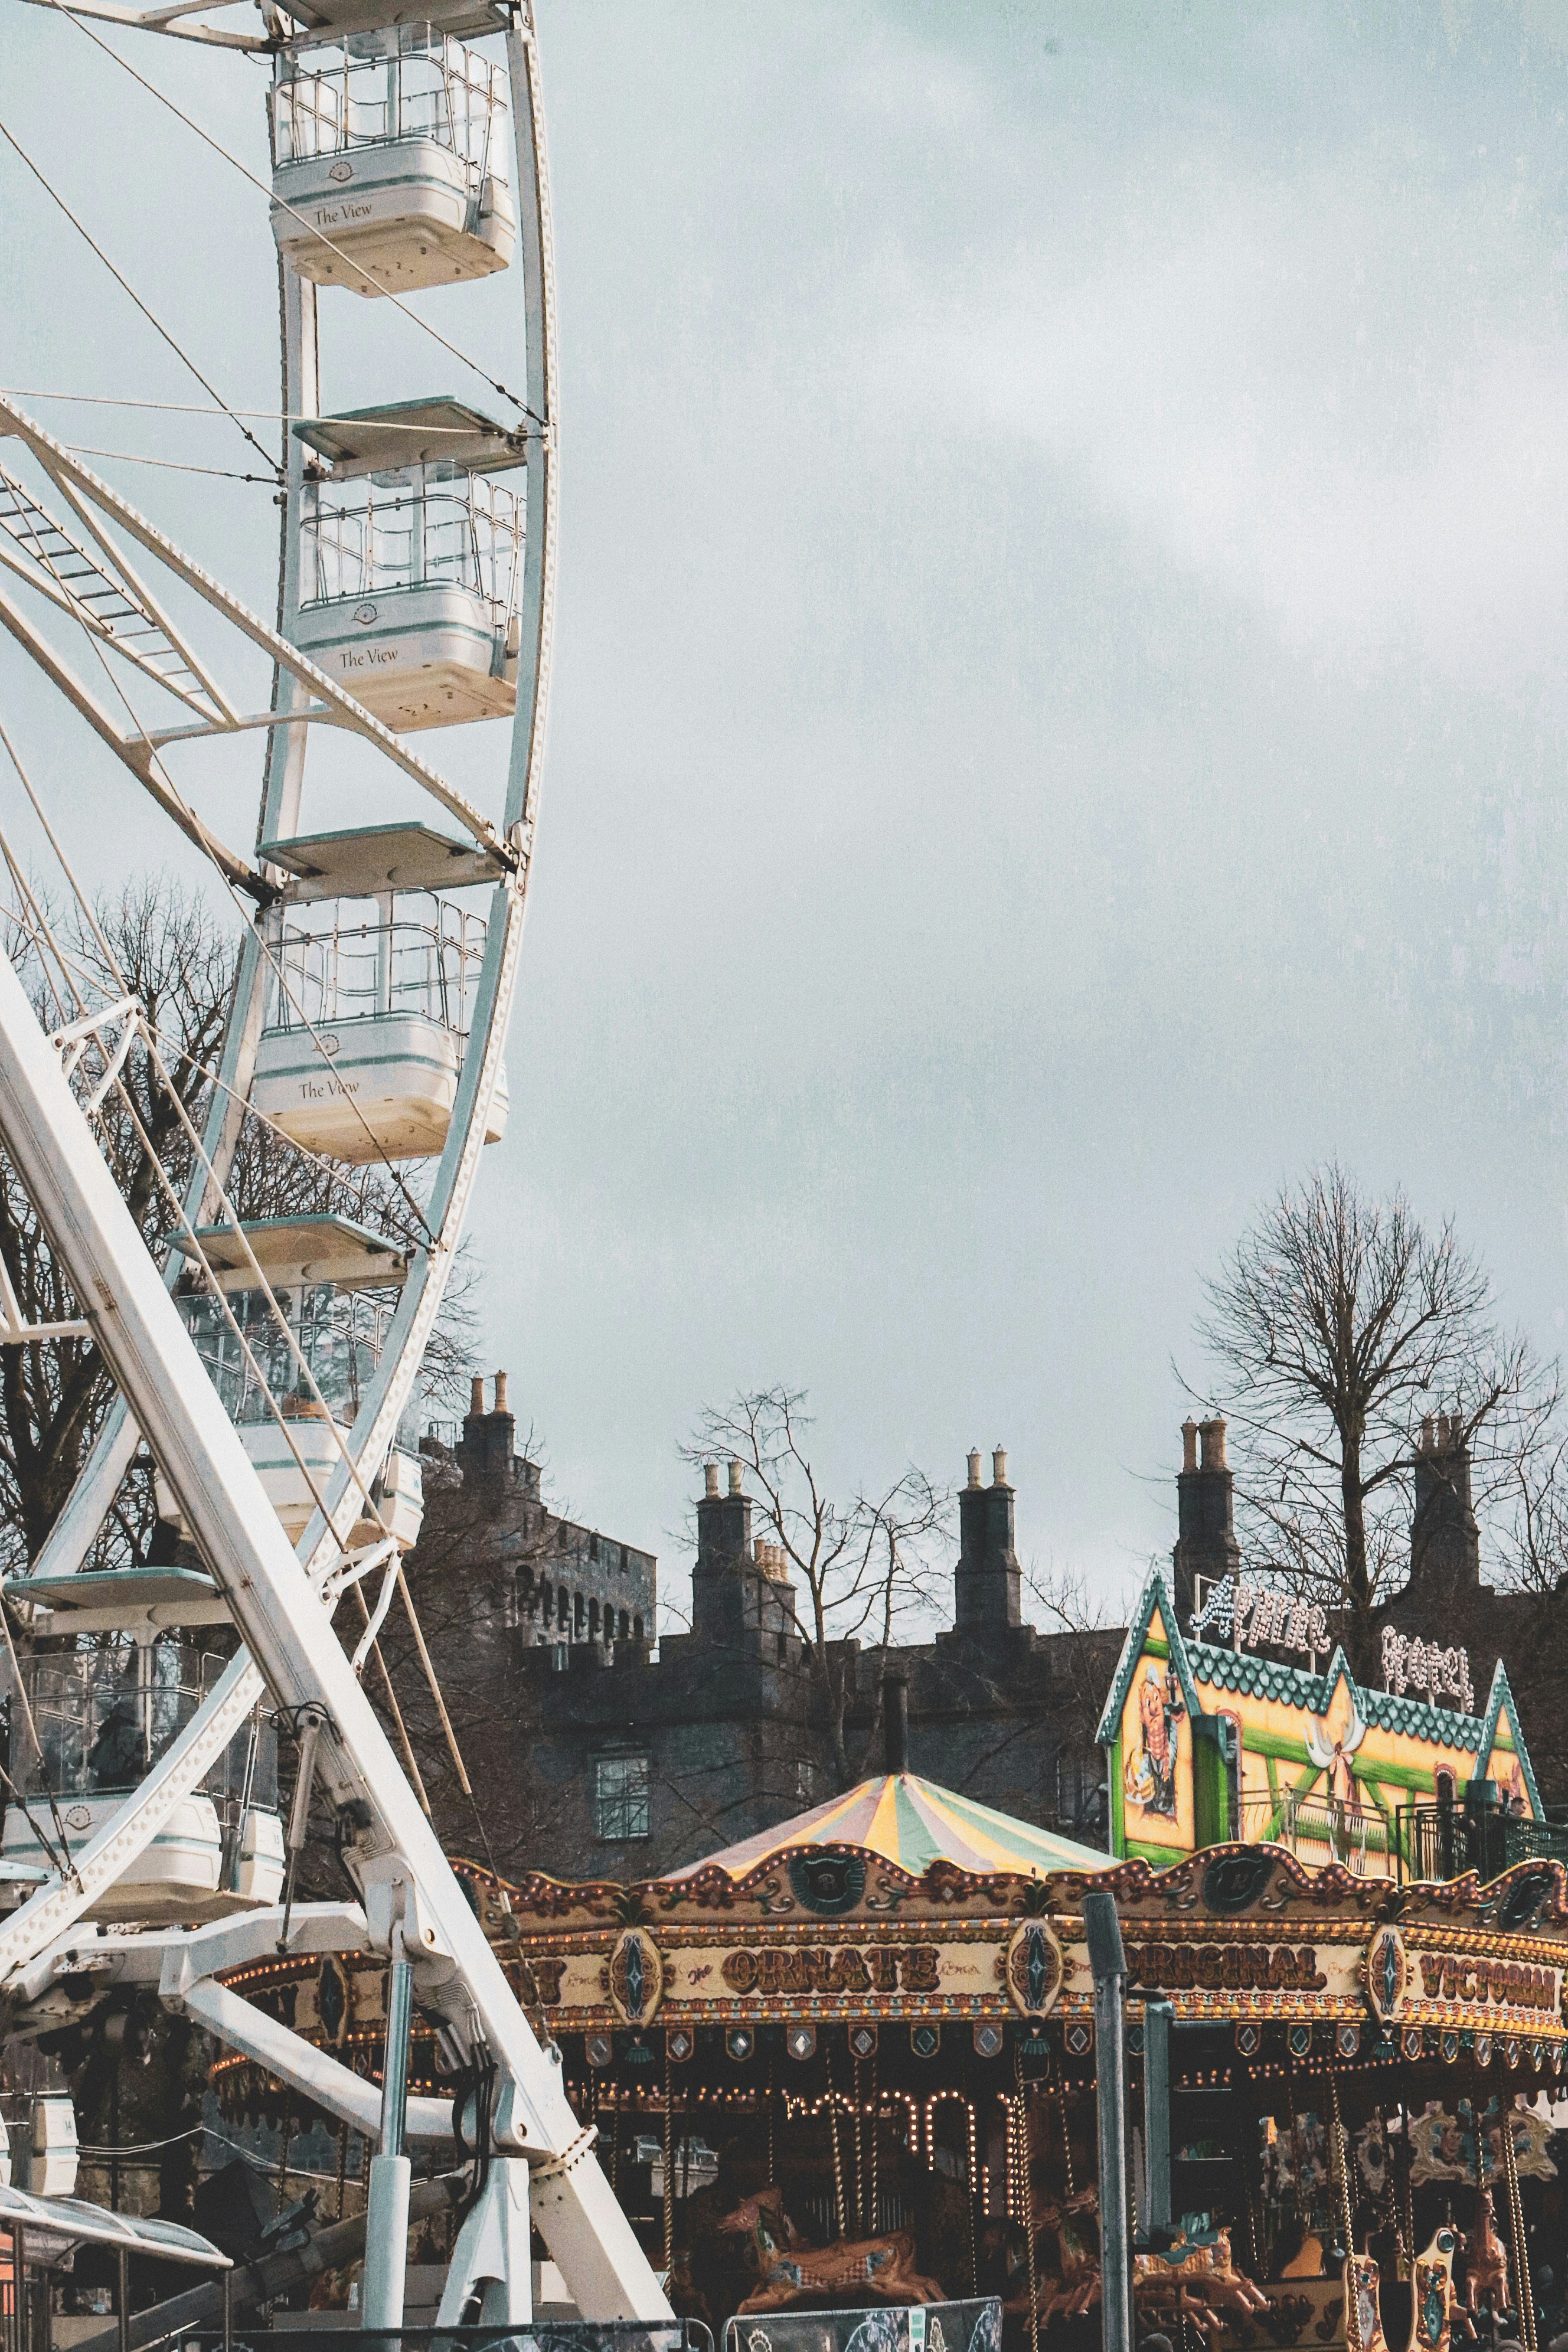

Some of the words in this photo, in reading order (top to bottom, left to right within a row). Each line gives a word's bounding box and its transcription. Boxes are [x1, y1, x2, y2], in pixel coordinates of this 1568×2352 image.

[314, 209, 341, 226] The
[342, 203, 373, 220] View
[339, 650, 364, 668] The
[366, 649, 398, 665] View
[299, 1082, 324, 1099] The
[721, 1946, 940, 1995] ORNATE
[1419, 1953, 1555, 2013] VICTORIAN
